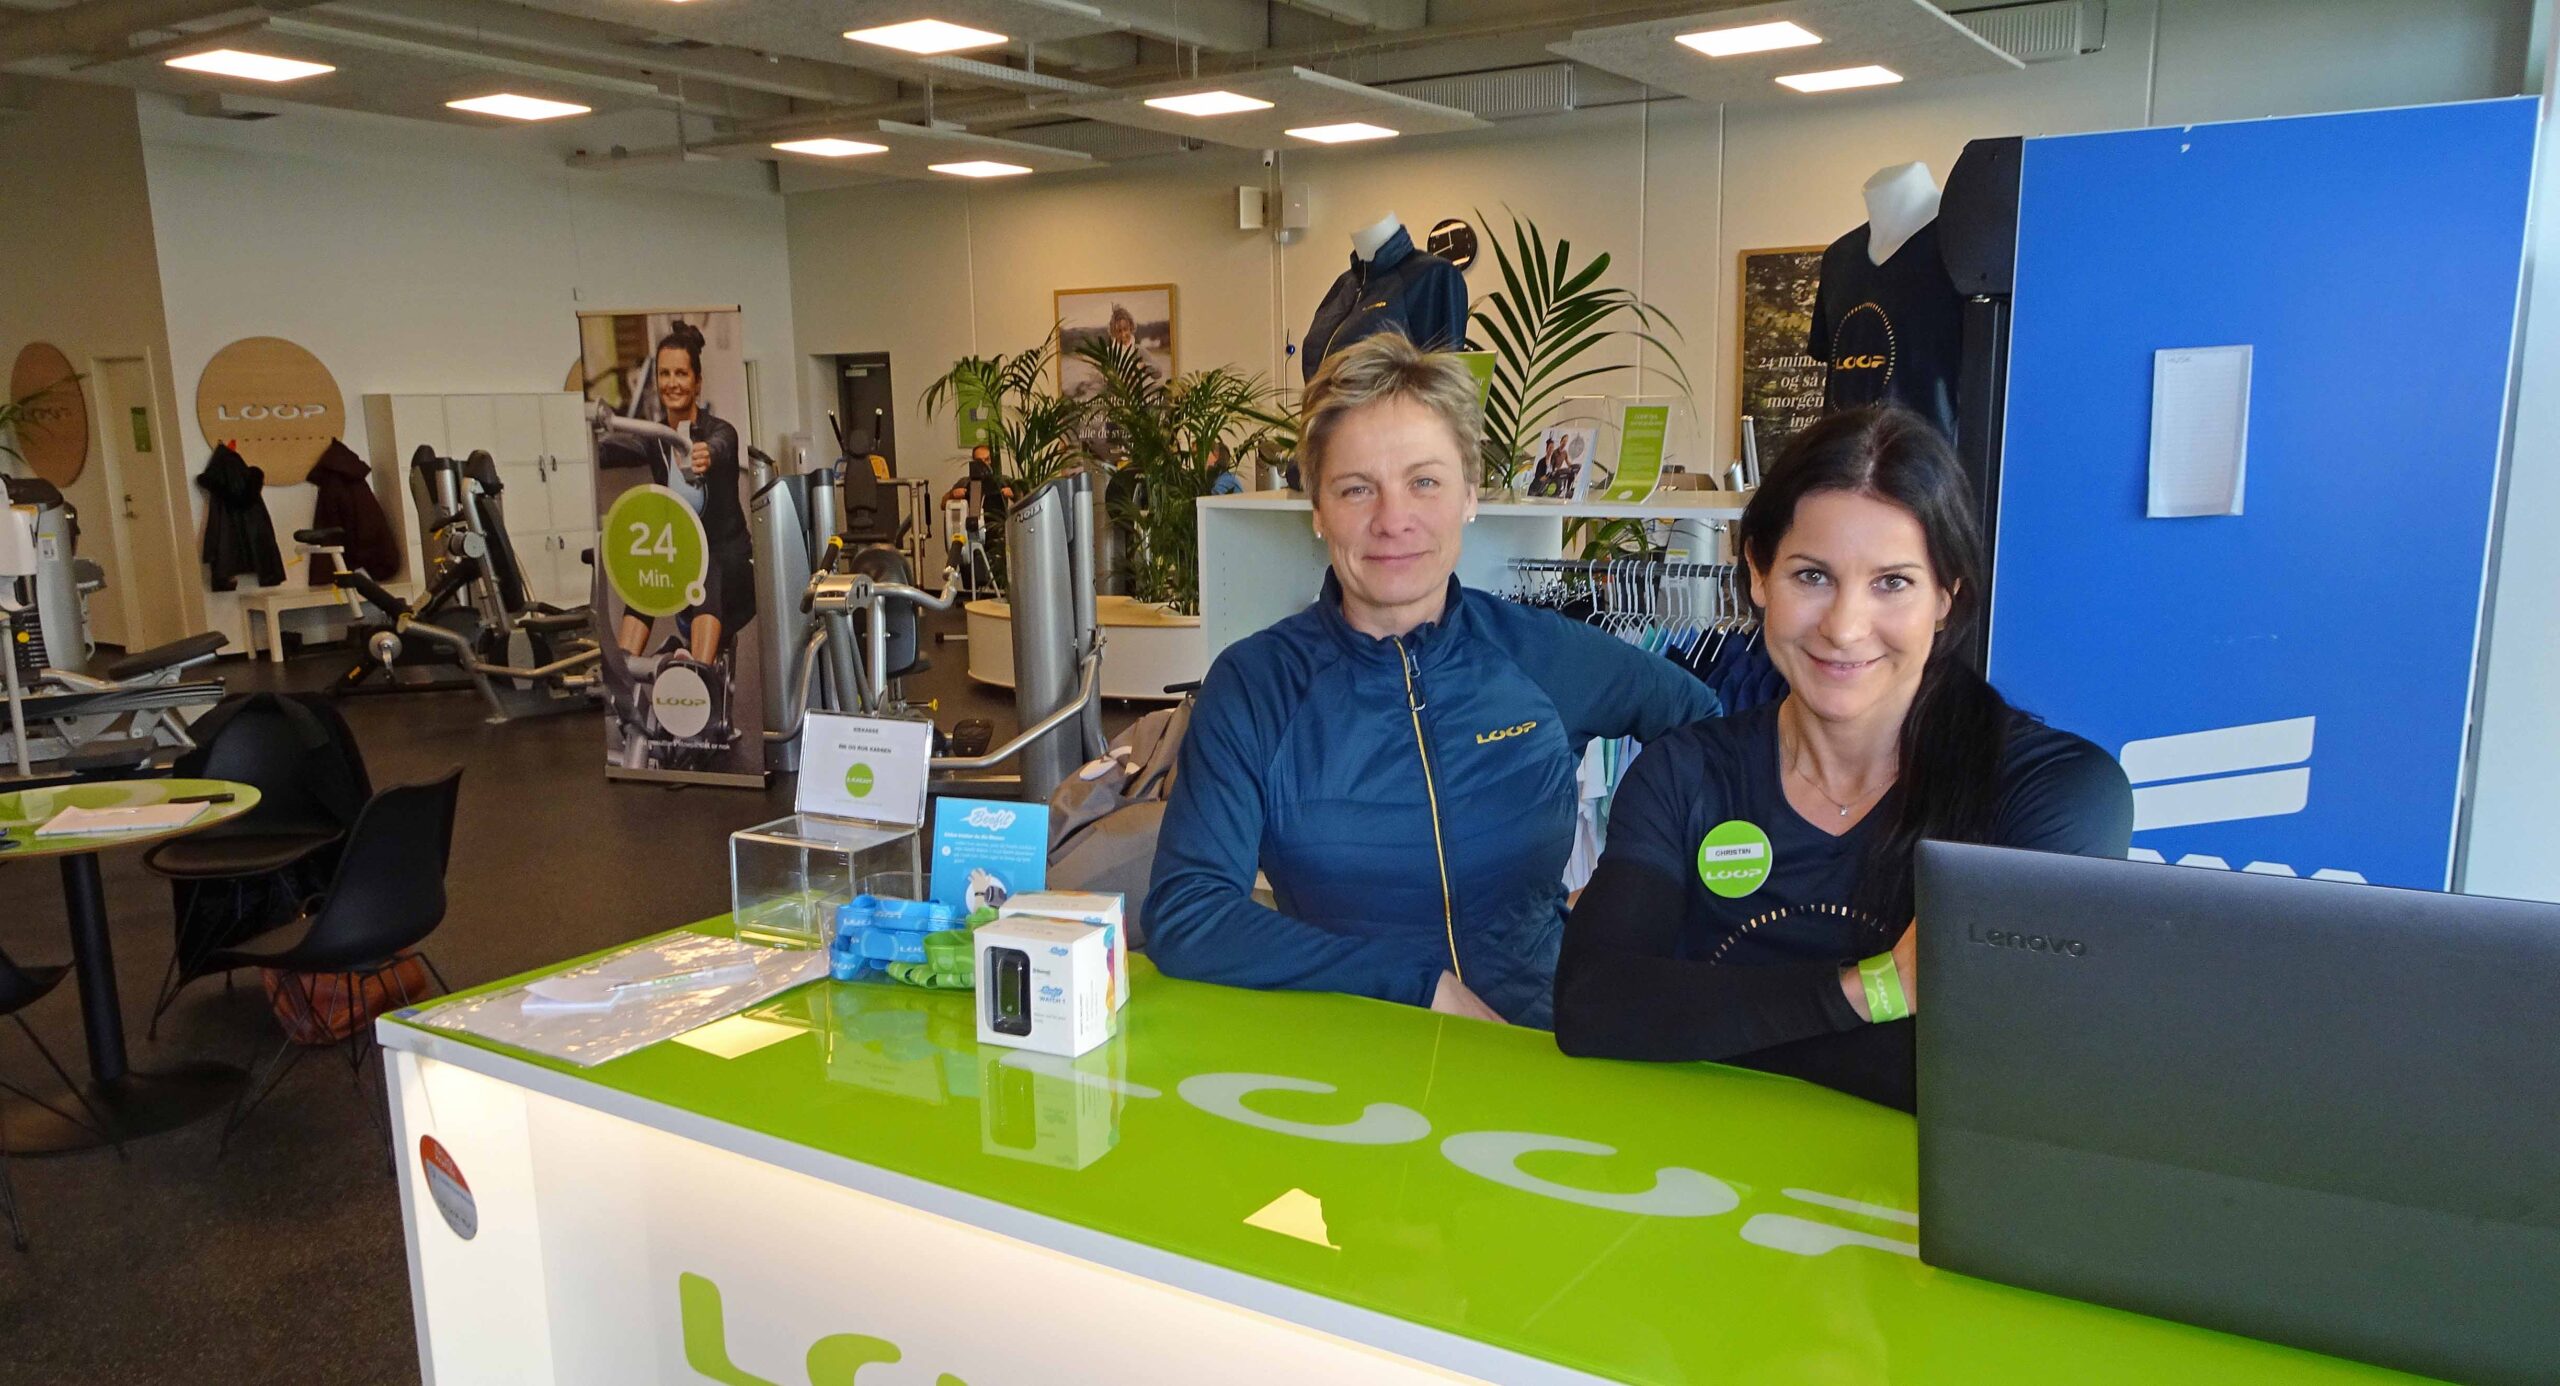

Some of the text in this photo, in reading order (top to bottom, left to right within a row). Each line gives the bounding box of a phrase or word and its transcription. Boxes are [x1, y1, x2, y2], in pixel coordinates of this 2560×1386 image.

[1758, 357, 1775, 369] 24
[1835, 355, 1887, 370] LOOP
[1781, 371, 1819, 392] og så
[1767, 394, 1825, 411] morgen
[217, 403, 328, 421] LOOP
[629, 521, 678, 564] 24
[639, 569, 675, 588] Min.
[656, 697, 707, 706] LOOP
[1476, 721, 1537, 744] LOOP
[1706, 868, 1763, 880] LOOP
[1968, 922, 2087, 957] Lenovo
